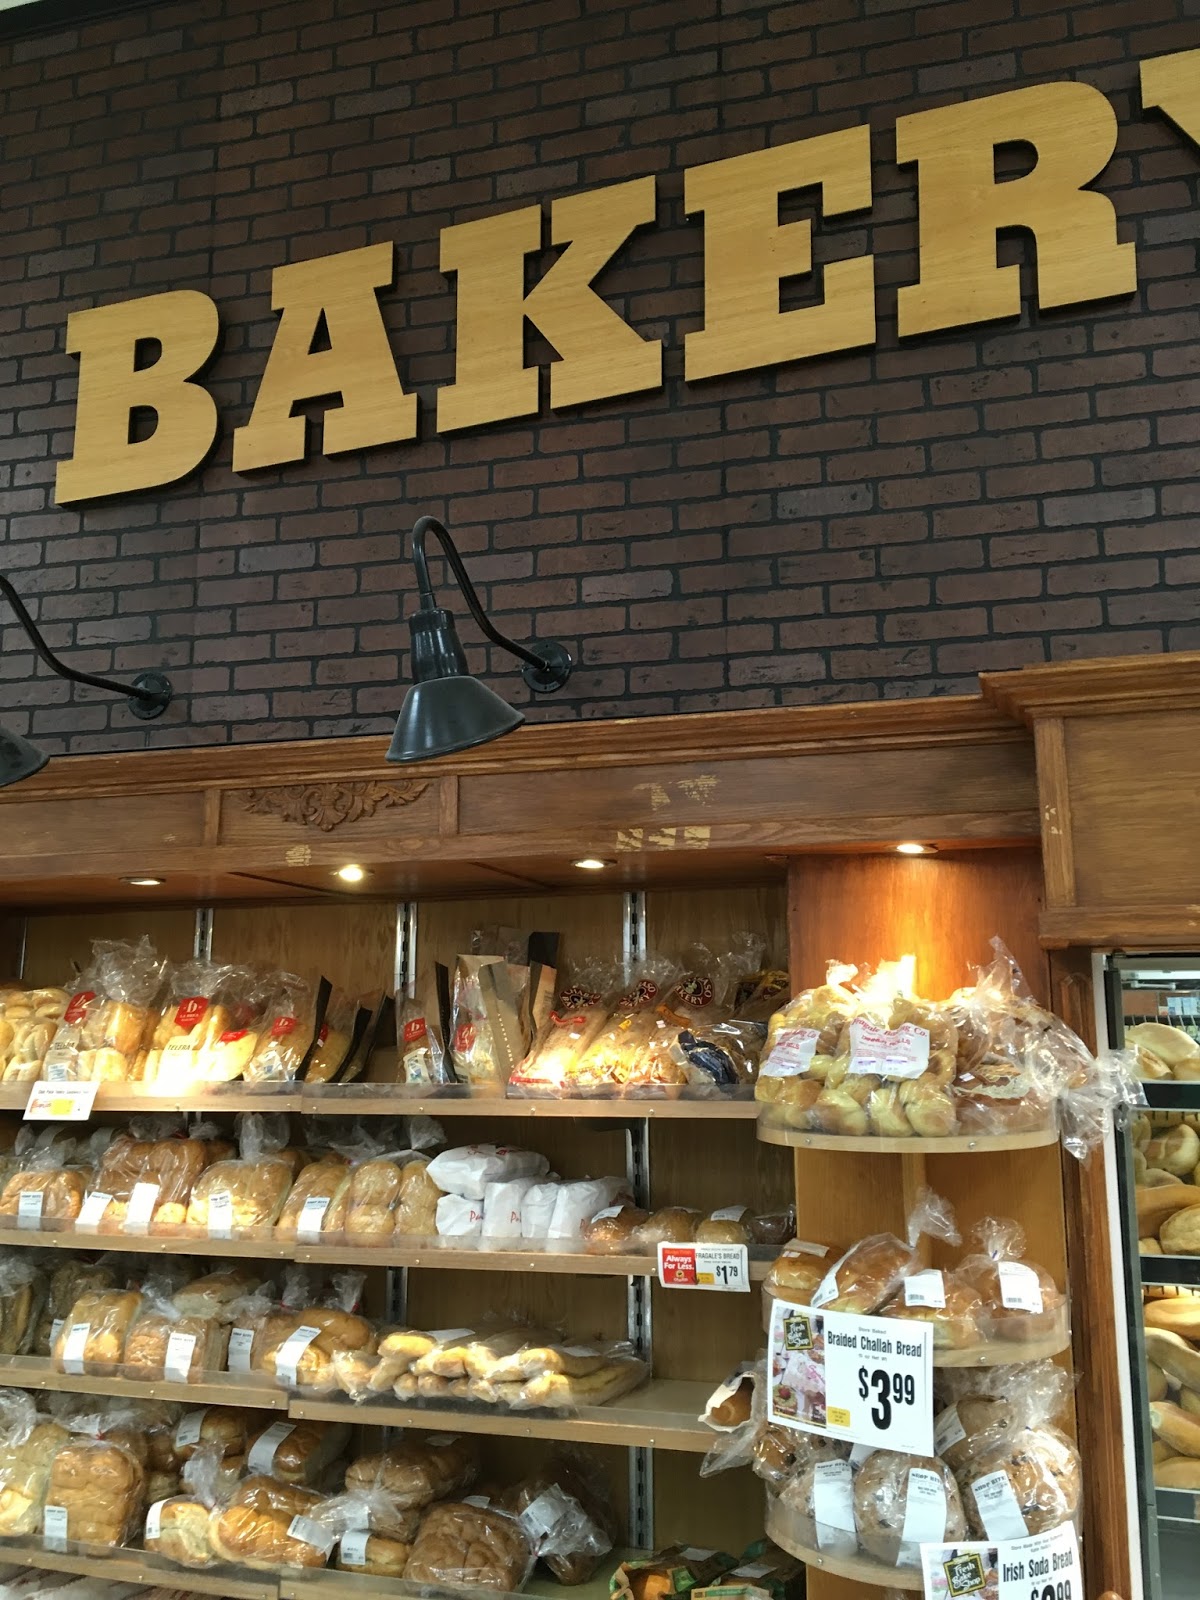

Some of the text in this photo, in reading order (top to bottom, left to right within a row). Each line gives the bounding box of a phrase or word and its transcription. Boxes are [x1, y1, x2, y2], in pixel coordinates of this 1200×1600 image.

[56, 48, 1200, 504] BAKER
[664, 1262, 676, 1270] For
[665, 1254, 691, 1264] Always
[827, 1331, 922, 1357] Braided Challah Bread
[1003, 1562, 1025, 1582] Irish
[1029, 1556, 1049, 1578] Soda
[1052, 1547, 1073, 1572] Bread
